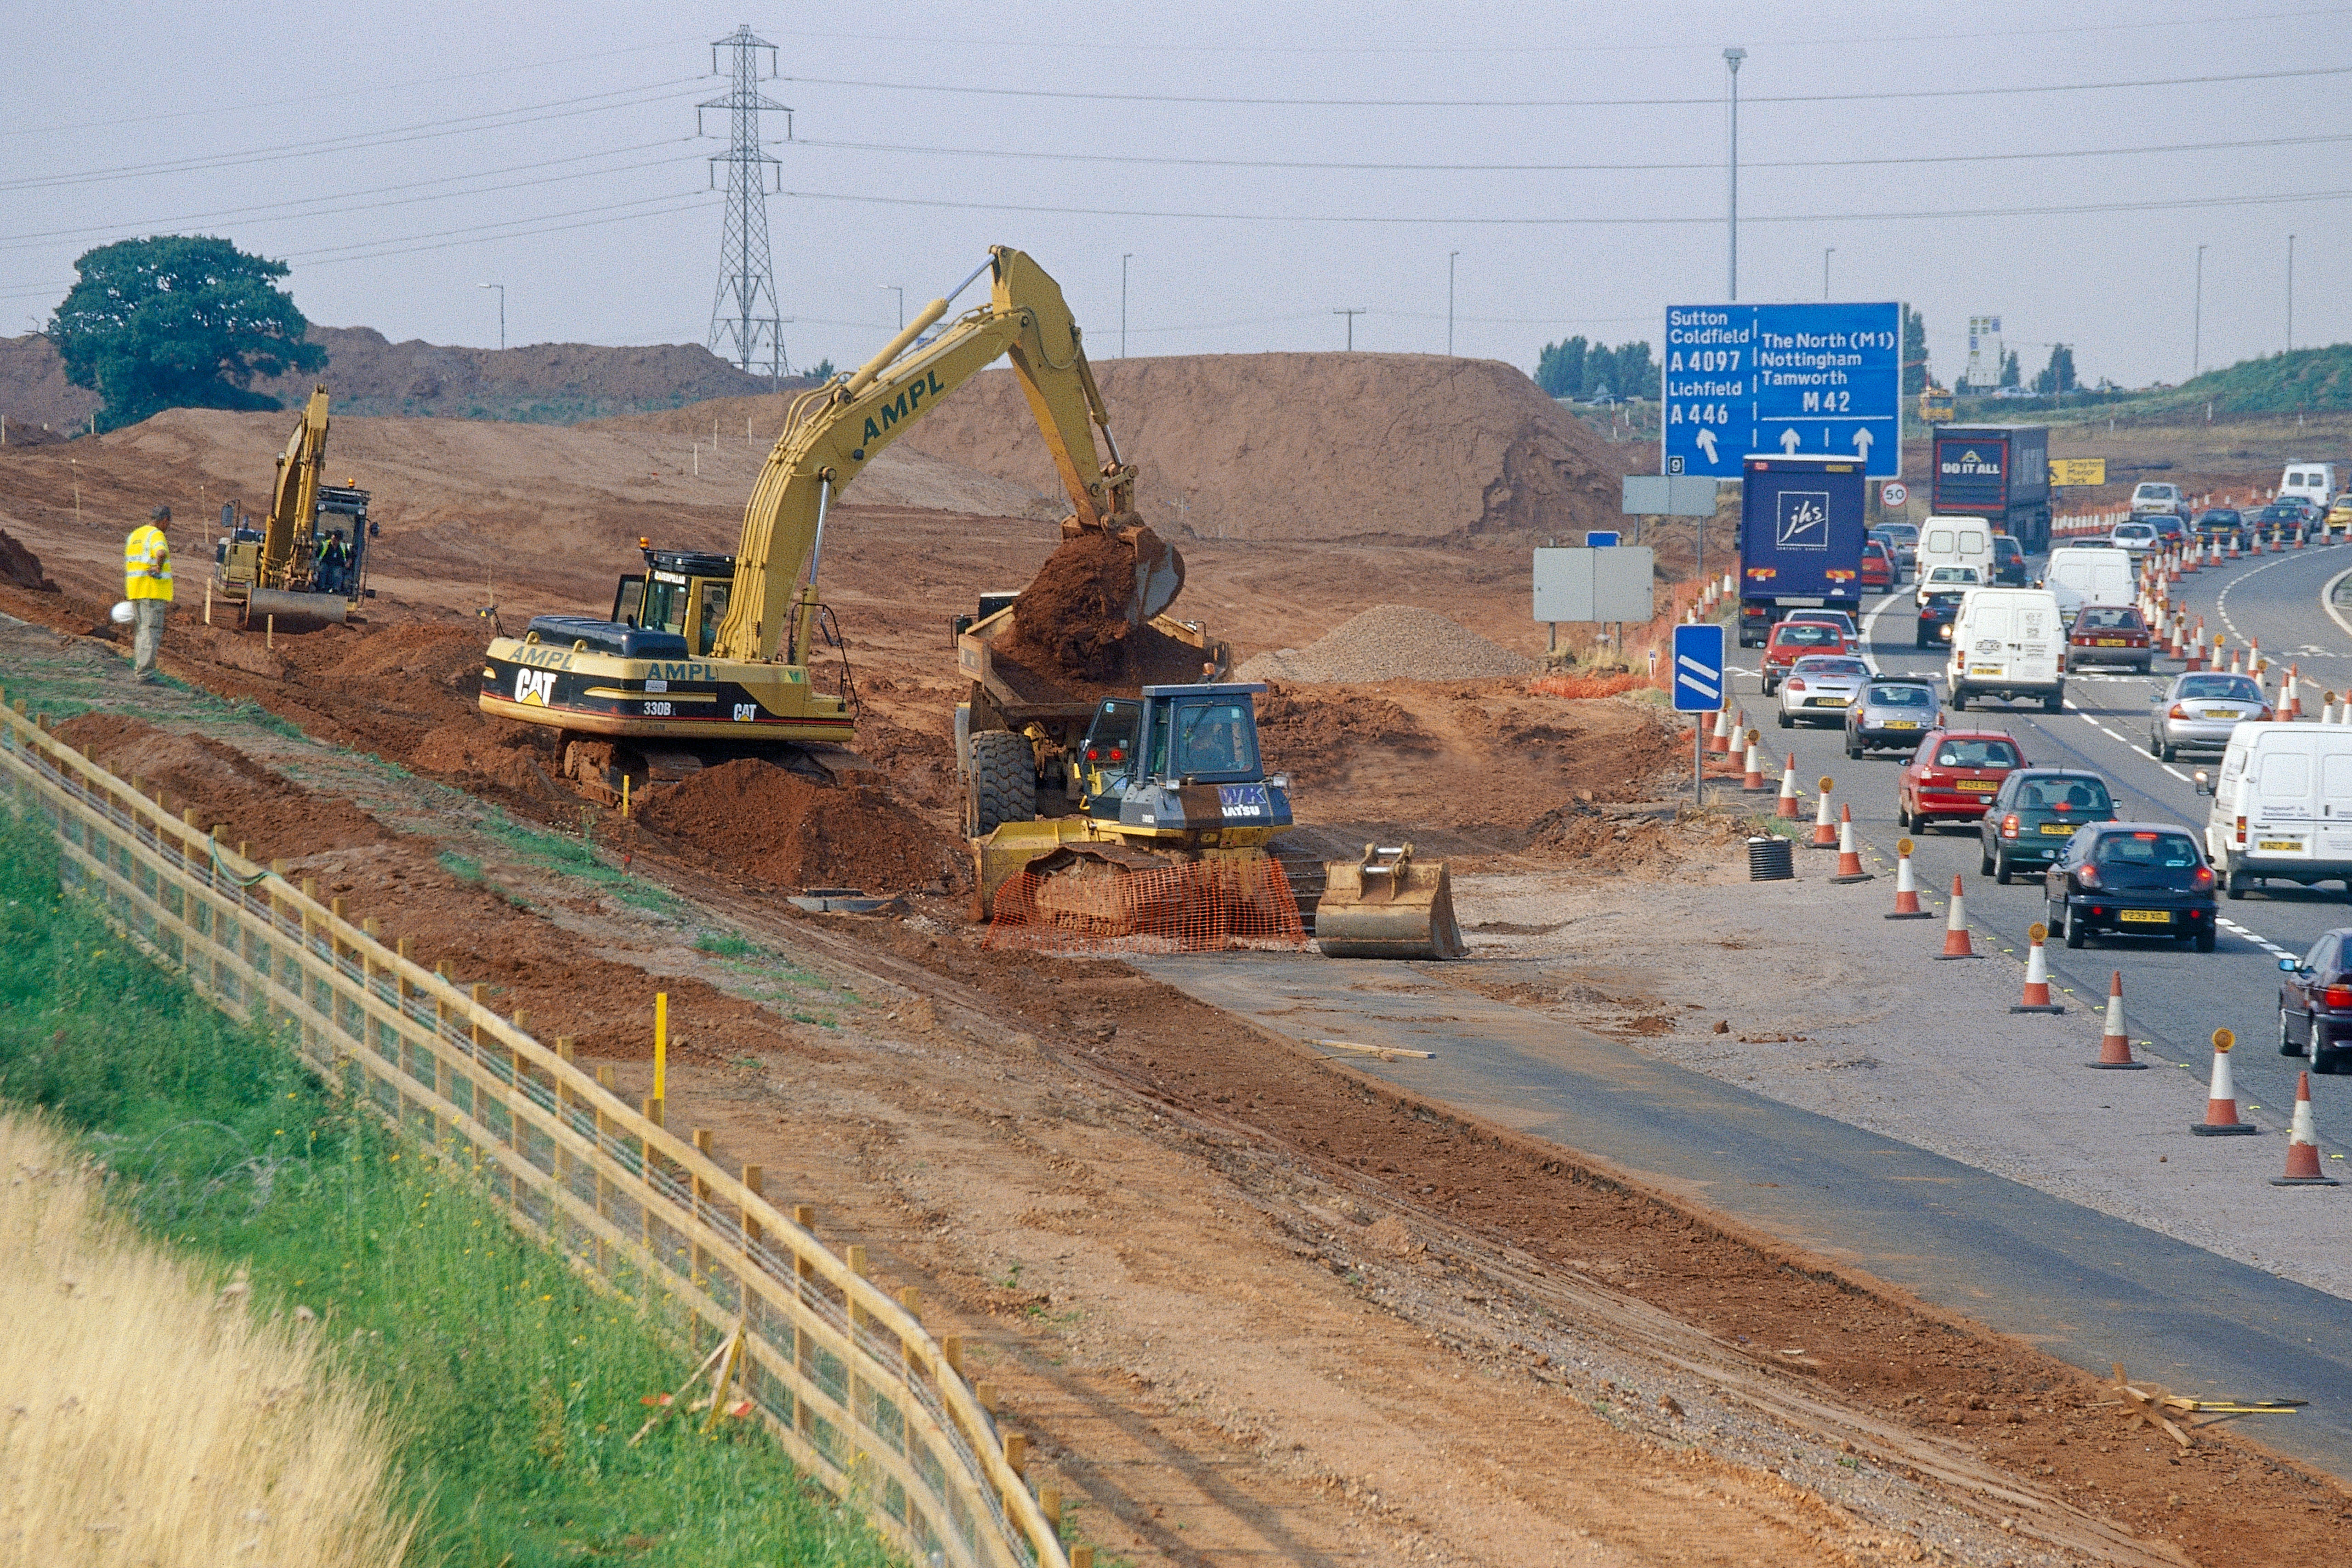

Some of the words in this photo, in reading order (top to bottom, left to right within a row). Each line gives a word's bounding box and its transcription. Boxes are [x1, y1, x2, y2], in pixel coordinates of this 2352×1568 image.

[1670, 311, 1728, 326] Sutton
[1670, 329, 1749, 344] Coldfield
[1762, 334, 1792, 348] The
[1796, 333, 1846, 348] North
[1762, 350, 1862, 369] Nottingham
[1763, 370, 1848, 386] Tamworth
[1670, 381, 1742, 397] Lichfield
[863, 370, 944, 446] AMPL
[1671, 459, 1681, 472] 9
[1942, 462, 1961, 474] DO
[1962, 463, 1975, 474] IT
[1977, 464, 2000, 474] ALL
[1886, 488, 1905, 500] 50
[1779, 500, 1822, 543] jhs
[508, 646, 572, 670] AMPL
[647, 662, 716, 681] AMPL
[515, 668, 558, 707] CAT
[644, 702, 671, 716] 330B
[733, 703, 756, 722] CAT
